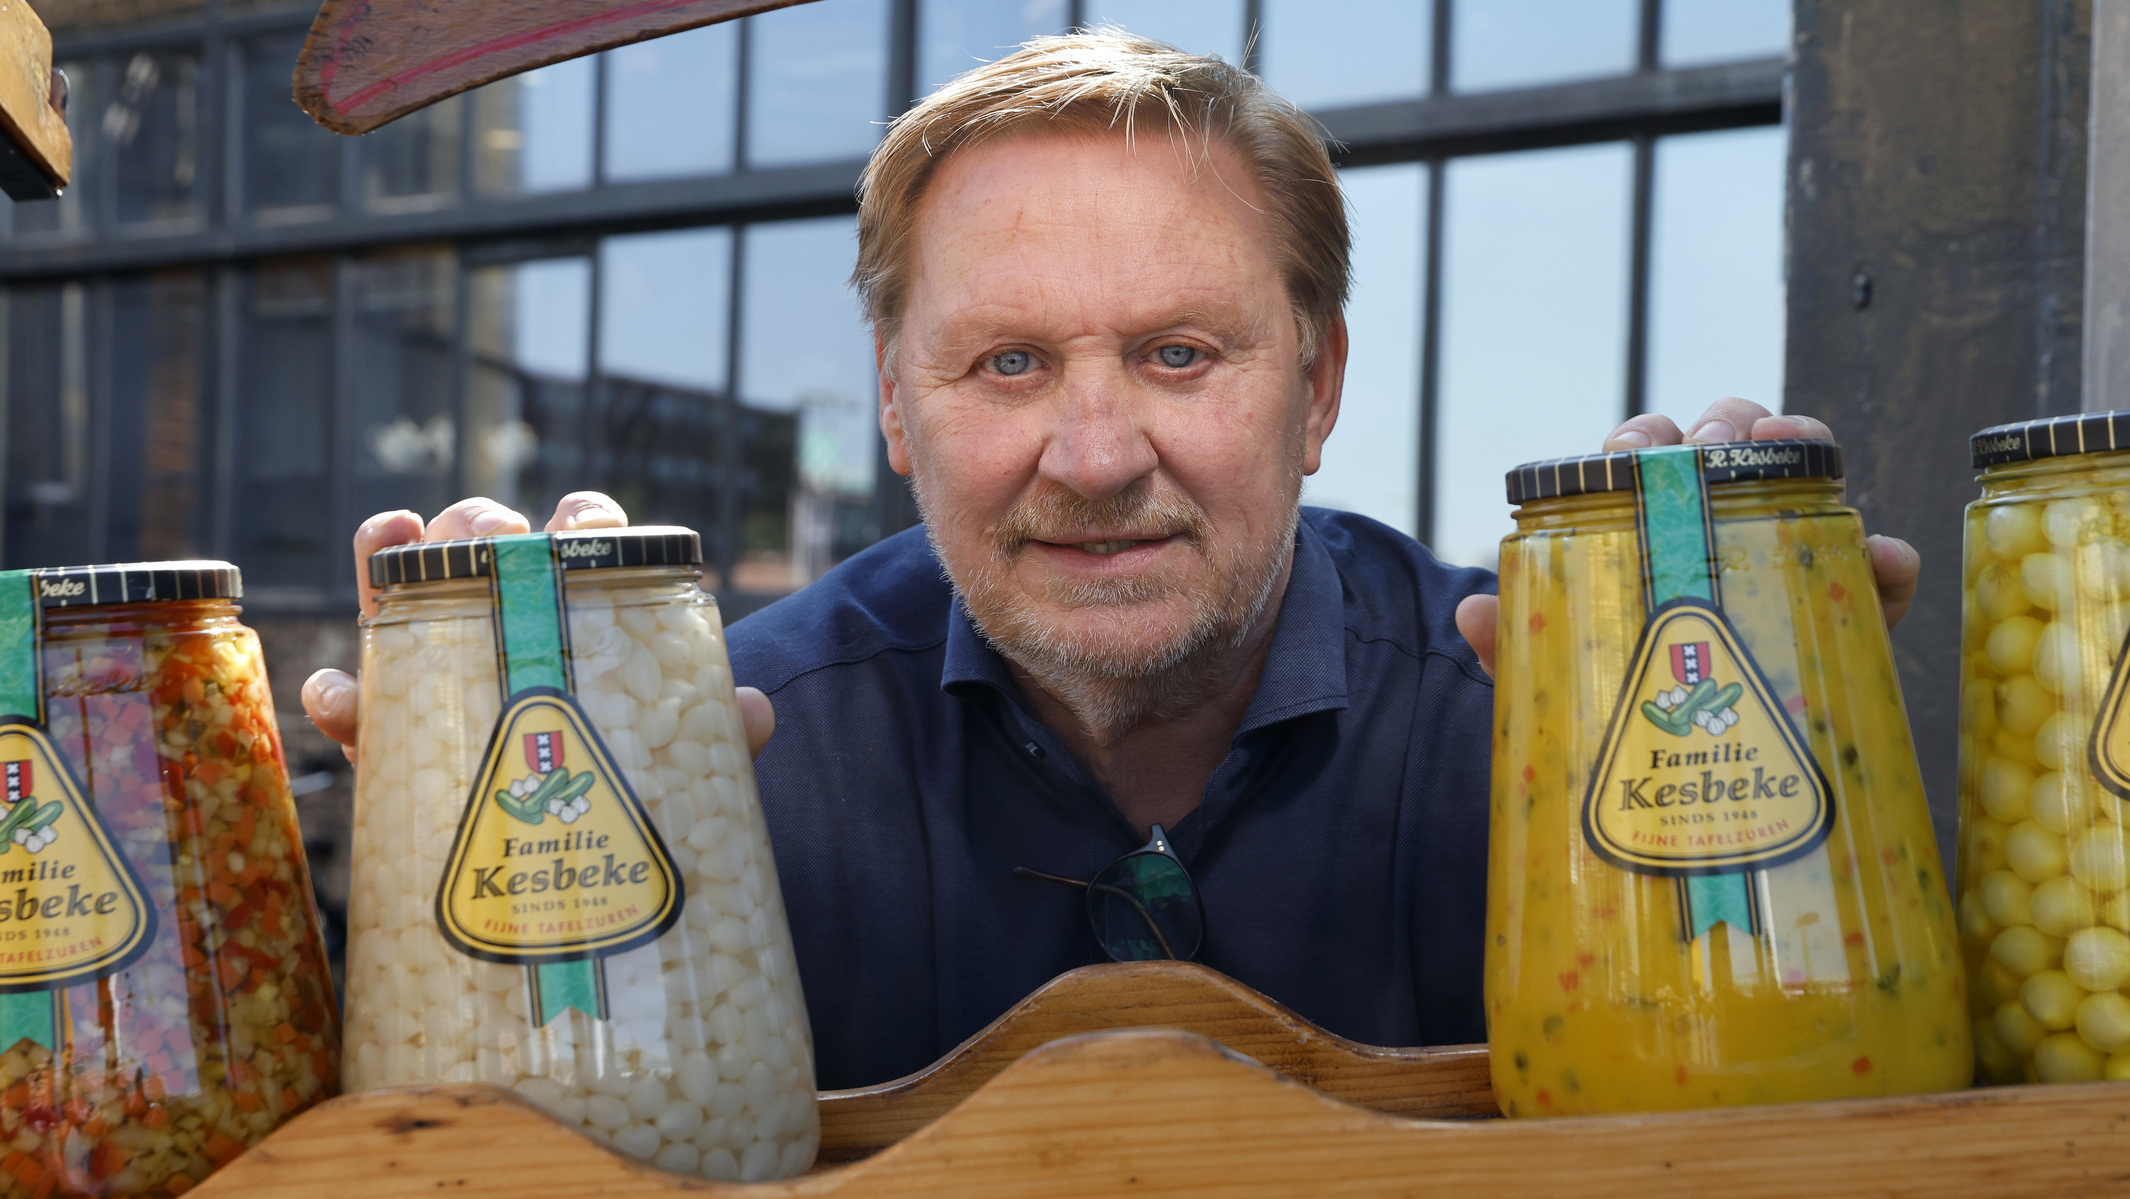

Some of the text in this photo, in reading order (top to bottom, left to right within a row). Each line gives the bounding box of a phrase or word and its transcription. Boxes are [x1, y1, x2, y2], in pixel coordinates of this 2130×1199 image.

[1730, 447, 1800, 466] Kesbeke
[1649, 743, 1758, 769] Familie
[1618, 766, 1800, 811] Kesbeke
[1660, 809, 1759, 827] SINDS 1948
[503, 830, 610, 858] Familie
[1632, 818, 1790, 847] FIJNE TAFELZUREN
[471, 853, 650, 900] Kesbeke
[512, 896, 609, 914] SINDS 1948
[34, 927, 71, 939] 1948
[484, 904, 639, 935] FIJNE TAFELZUREN
